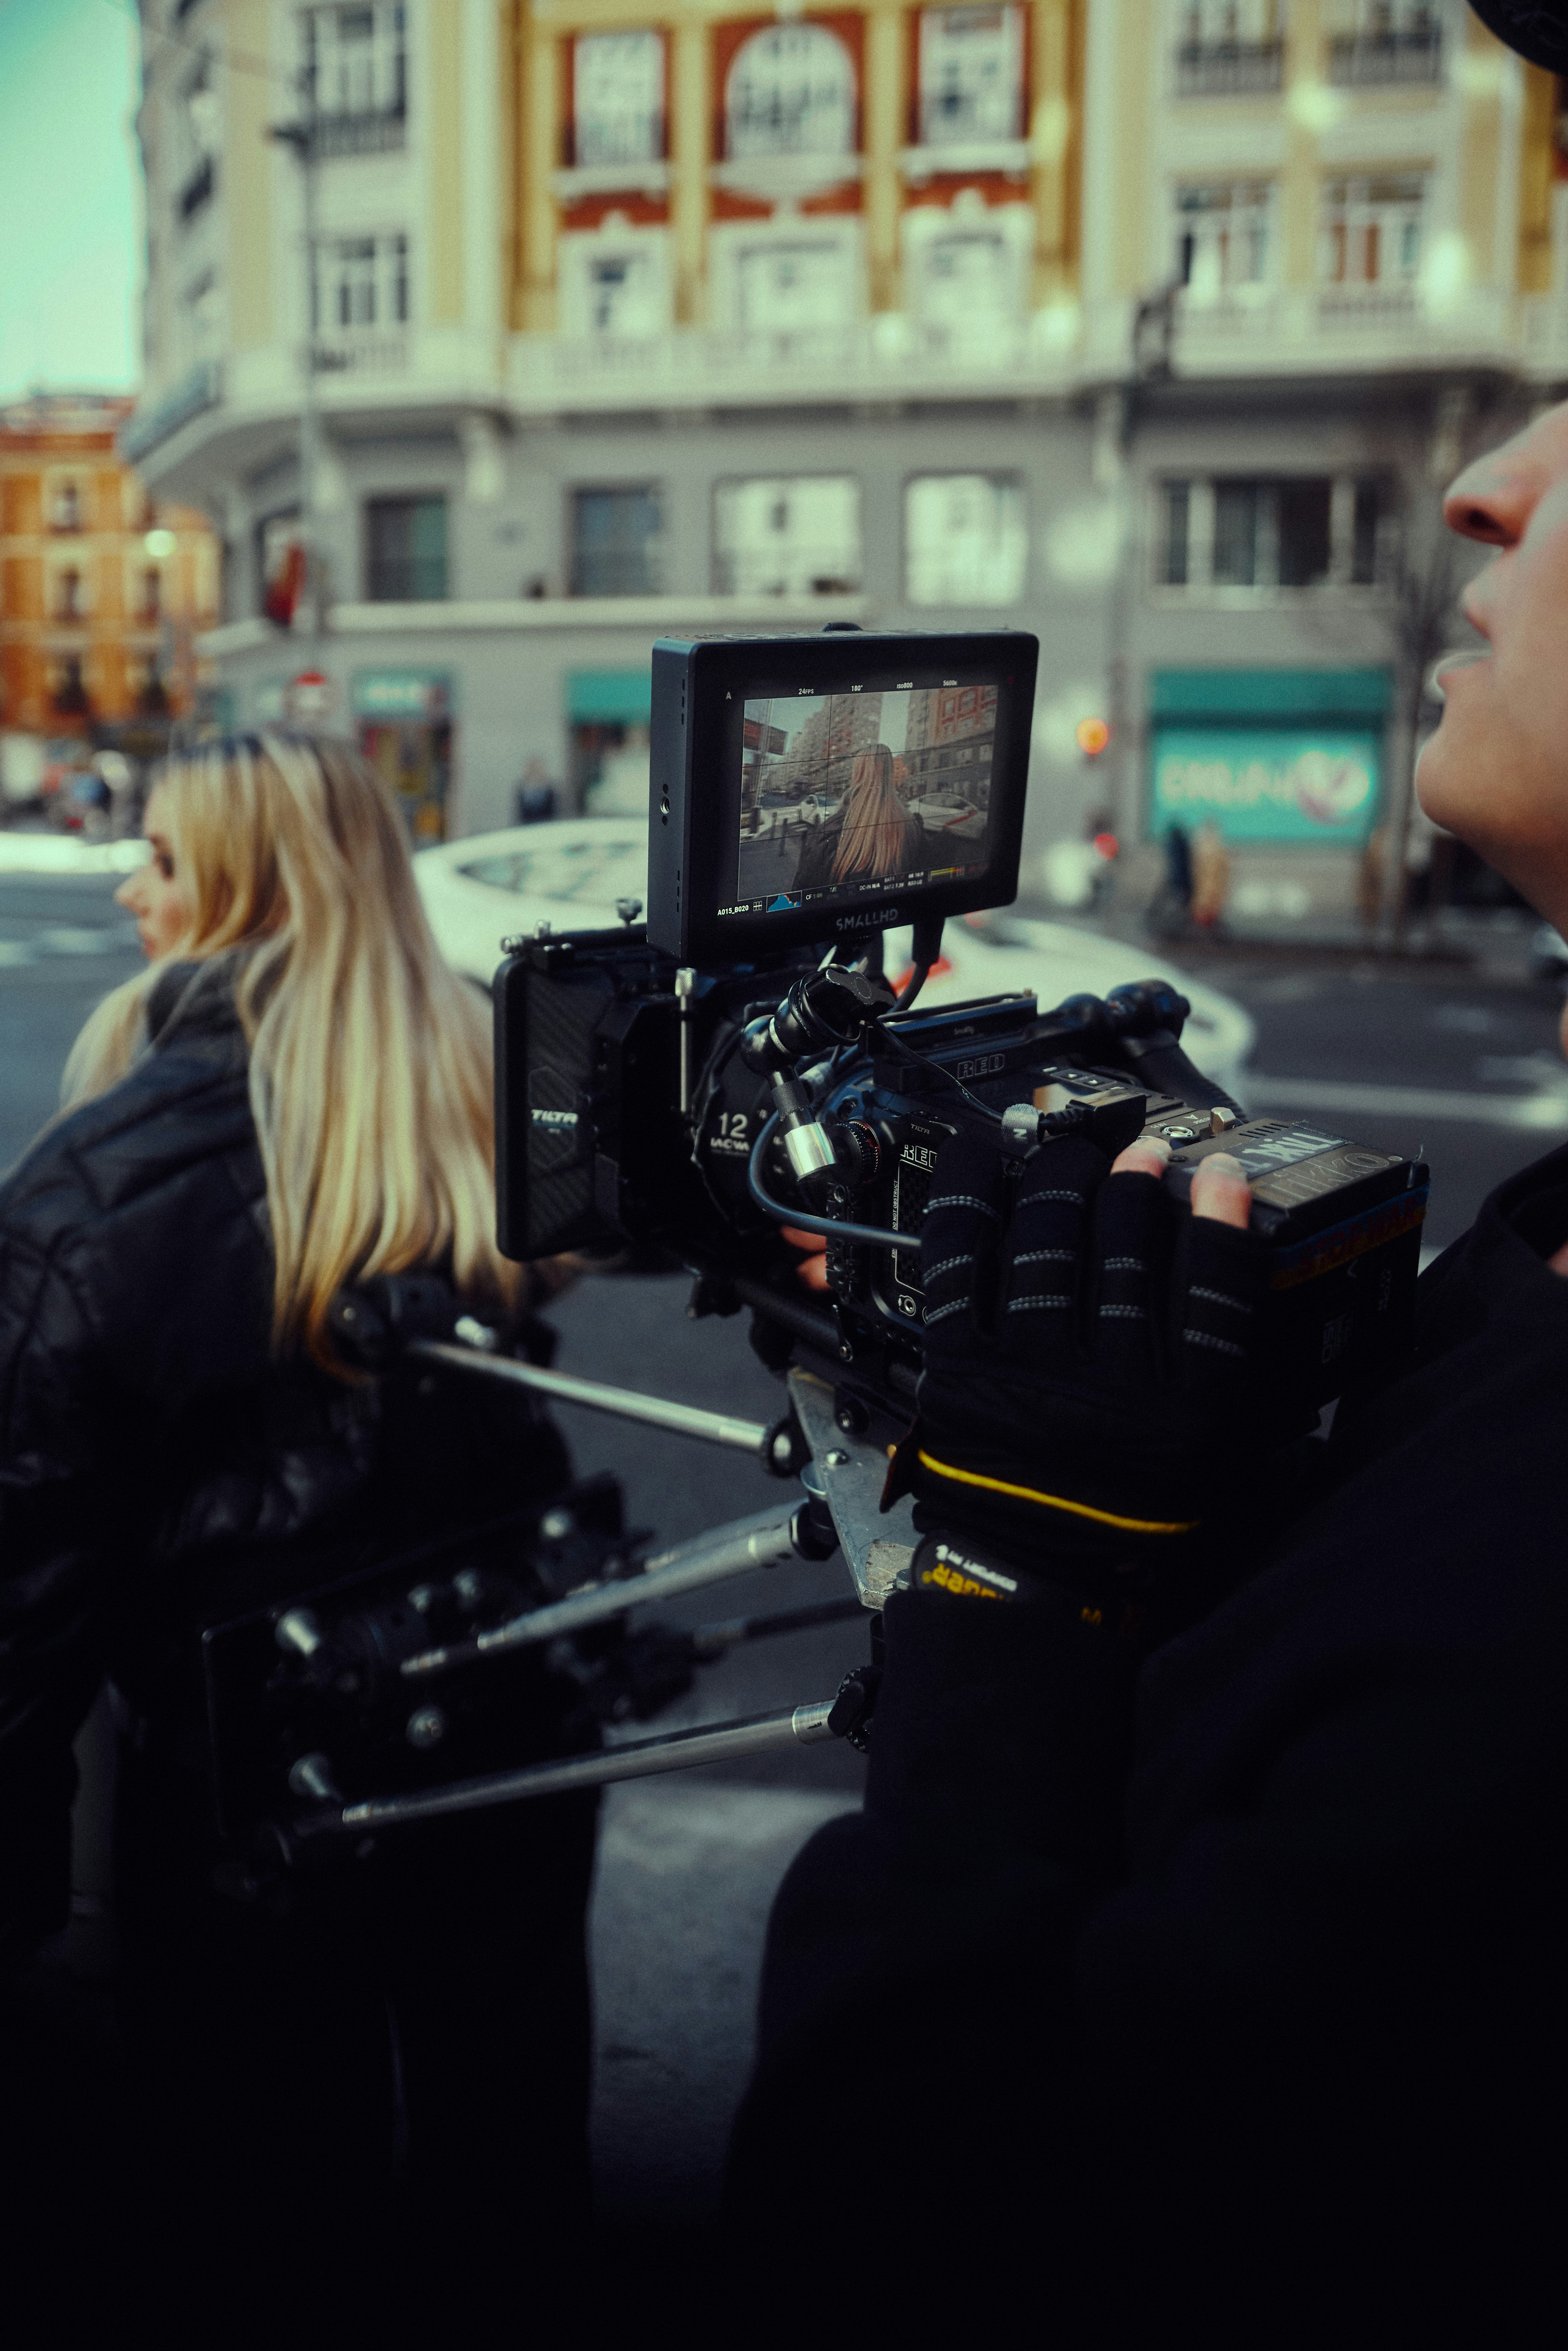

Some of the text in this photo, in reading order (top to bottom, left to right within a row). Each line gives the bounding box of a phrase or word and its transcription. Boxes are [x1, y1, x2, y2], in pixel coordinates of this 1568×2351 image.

[726, 691, 732, 700] A
[717, 905, 749, 916] A015_B020
[836, 908, 898, 931] SMALLHD
[957, 1053, 1005, 1080] RED
[531, 1109, 578, 1124] TILTA
[719, 1112, 748, 1138] 12
[910, 1124, 930, 1135] TILTA
[892, 1222, 897, 1231] DO
[1367, 1197, 1417, 1244] WAR
